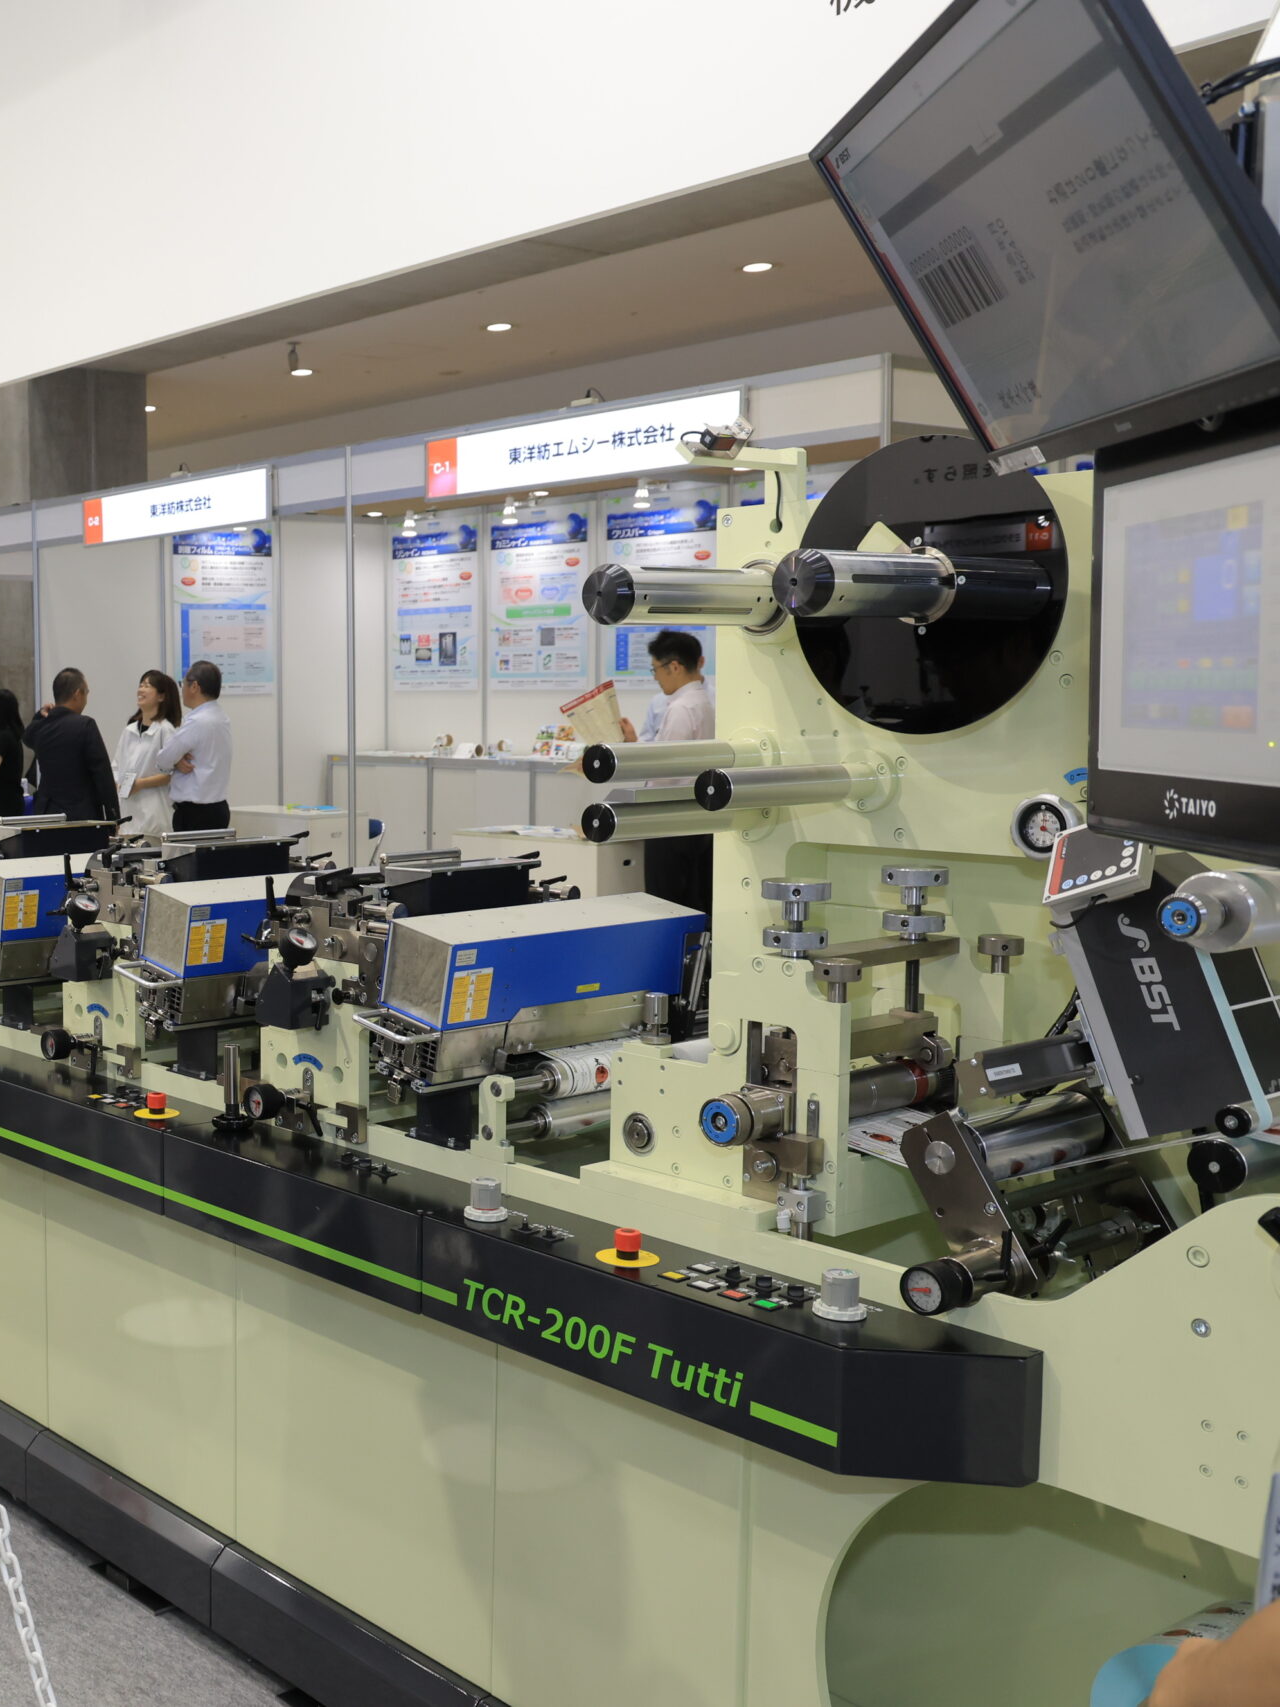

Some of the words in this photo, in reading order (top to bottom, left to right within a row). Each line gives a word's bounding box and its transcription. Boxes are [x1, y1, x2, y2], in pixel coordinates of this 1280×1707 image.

[508, 423, 675, 464] 東洋紡エムシー株式会社
[433, 461, 450, 474] C-1
[150, 495, 211, 517] 東洋紡株式会社
[1181, 797, 1216, 818] TAIYO
[1130, 957, 1180, 1031] BST
[462, 1278, 636, 1365] TCR-200F
[647, 1342, 745, 1408] Tutti
